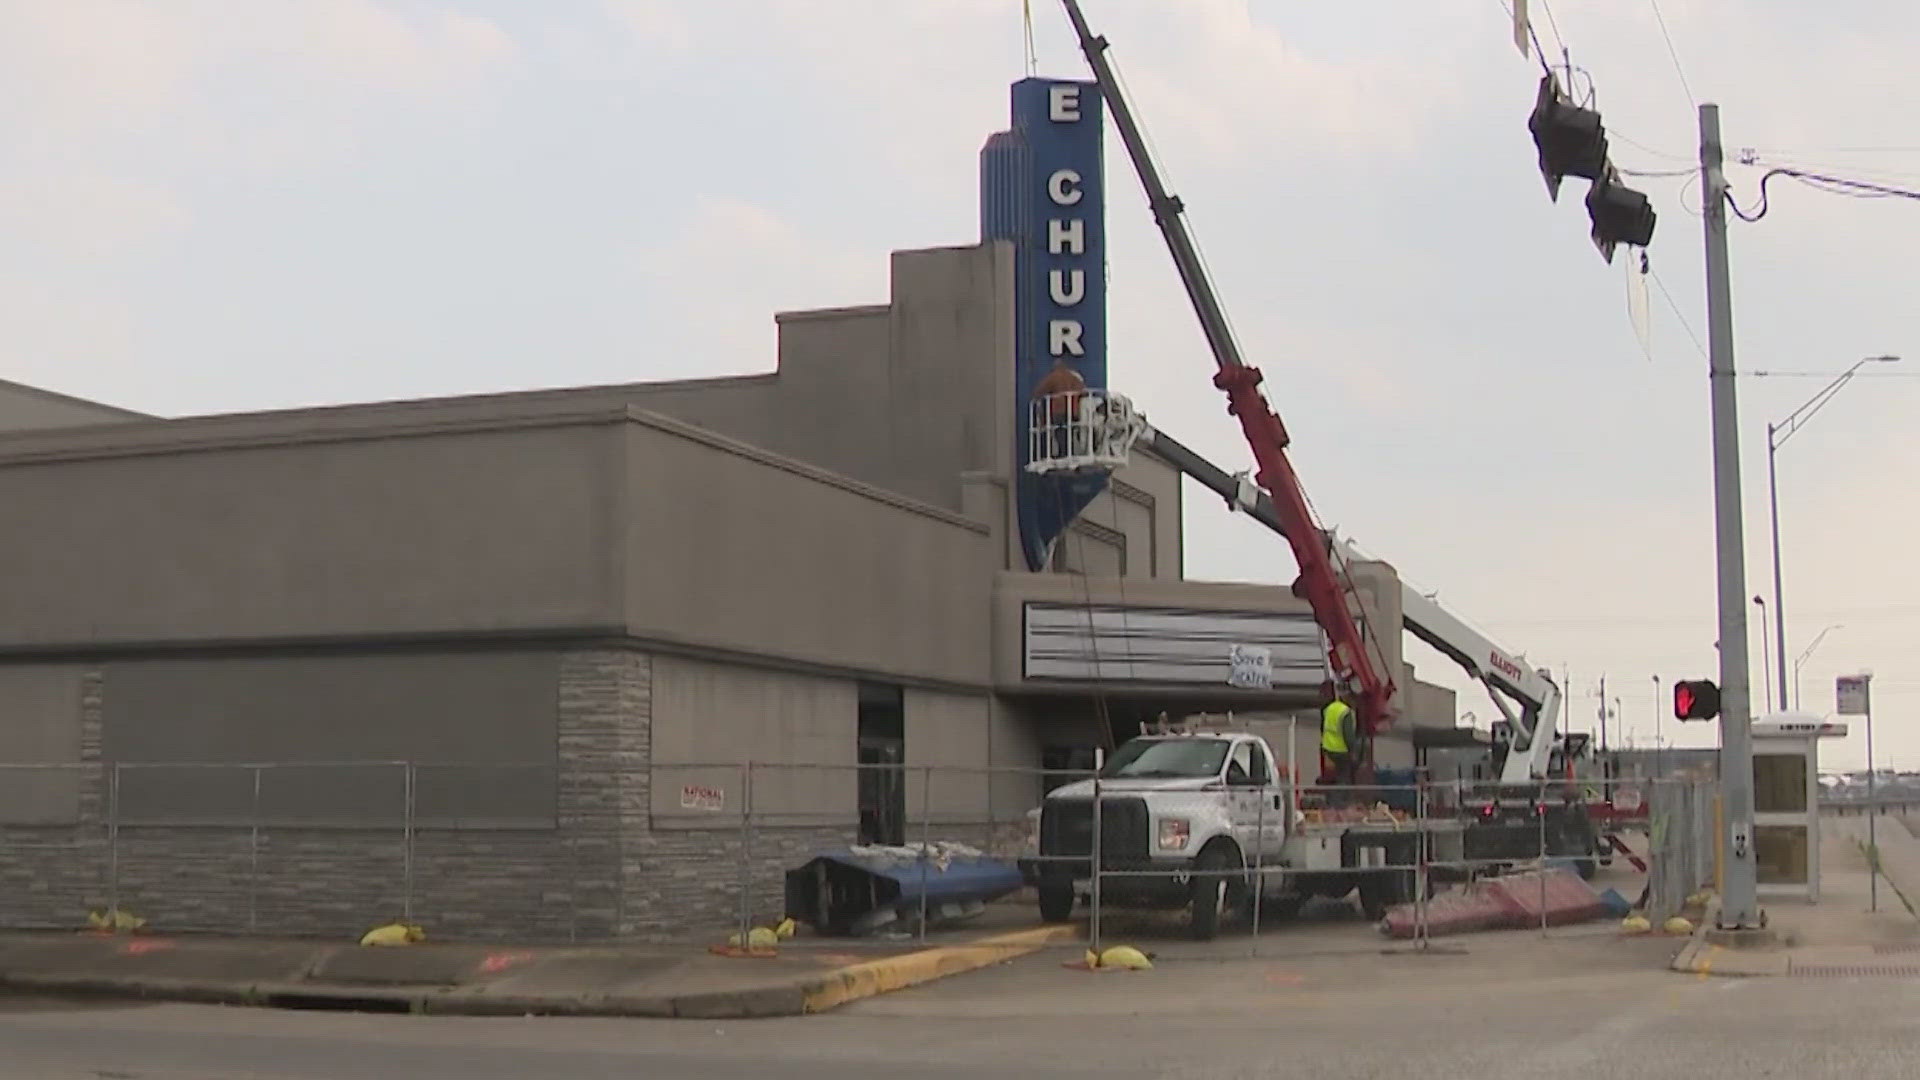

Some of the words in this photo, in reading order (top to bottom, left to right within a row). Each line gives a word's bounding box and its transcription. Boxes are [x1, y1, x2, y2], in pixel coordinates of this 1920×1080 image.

[1049, 86, 1081, 122] E
[1048, 168, 1085, 383] CHUR
[684, 786, 721, 800] NATIONAL
